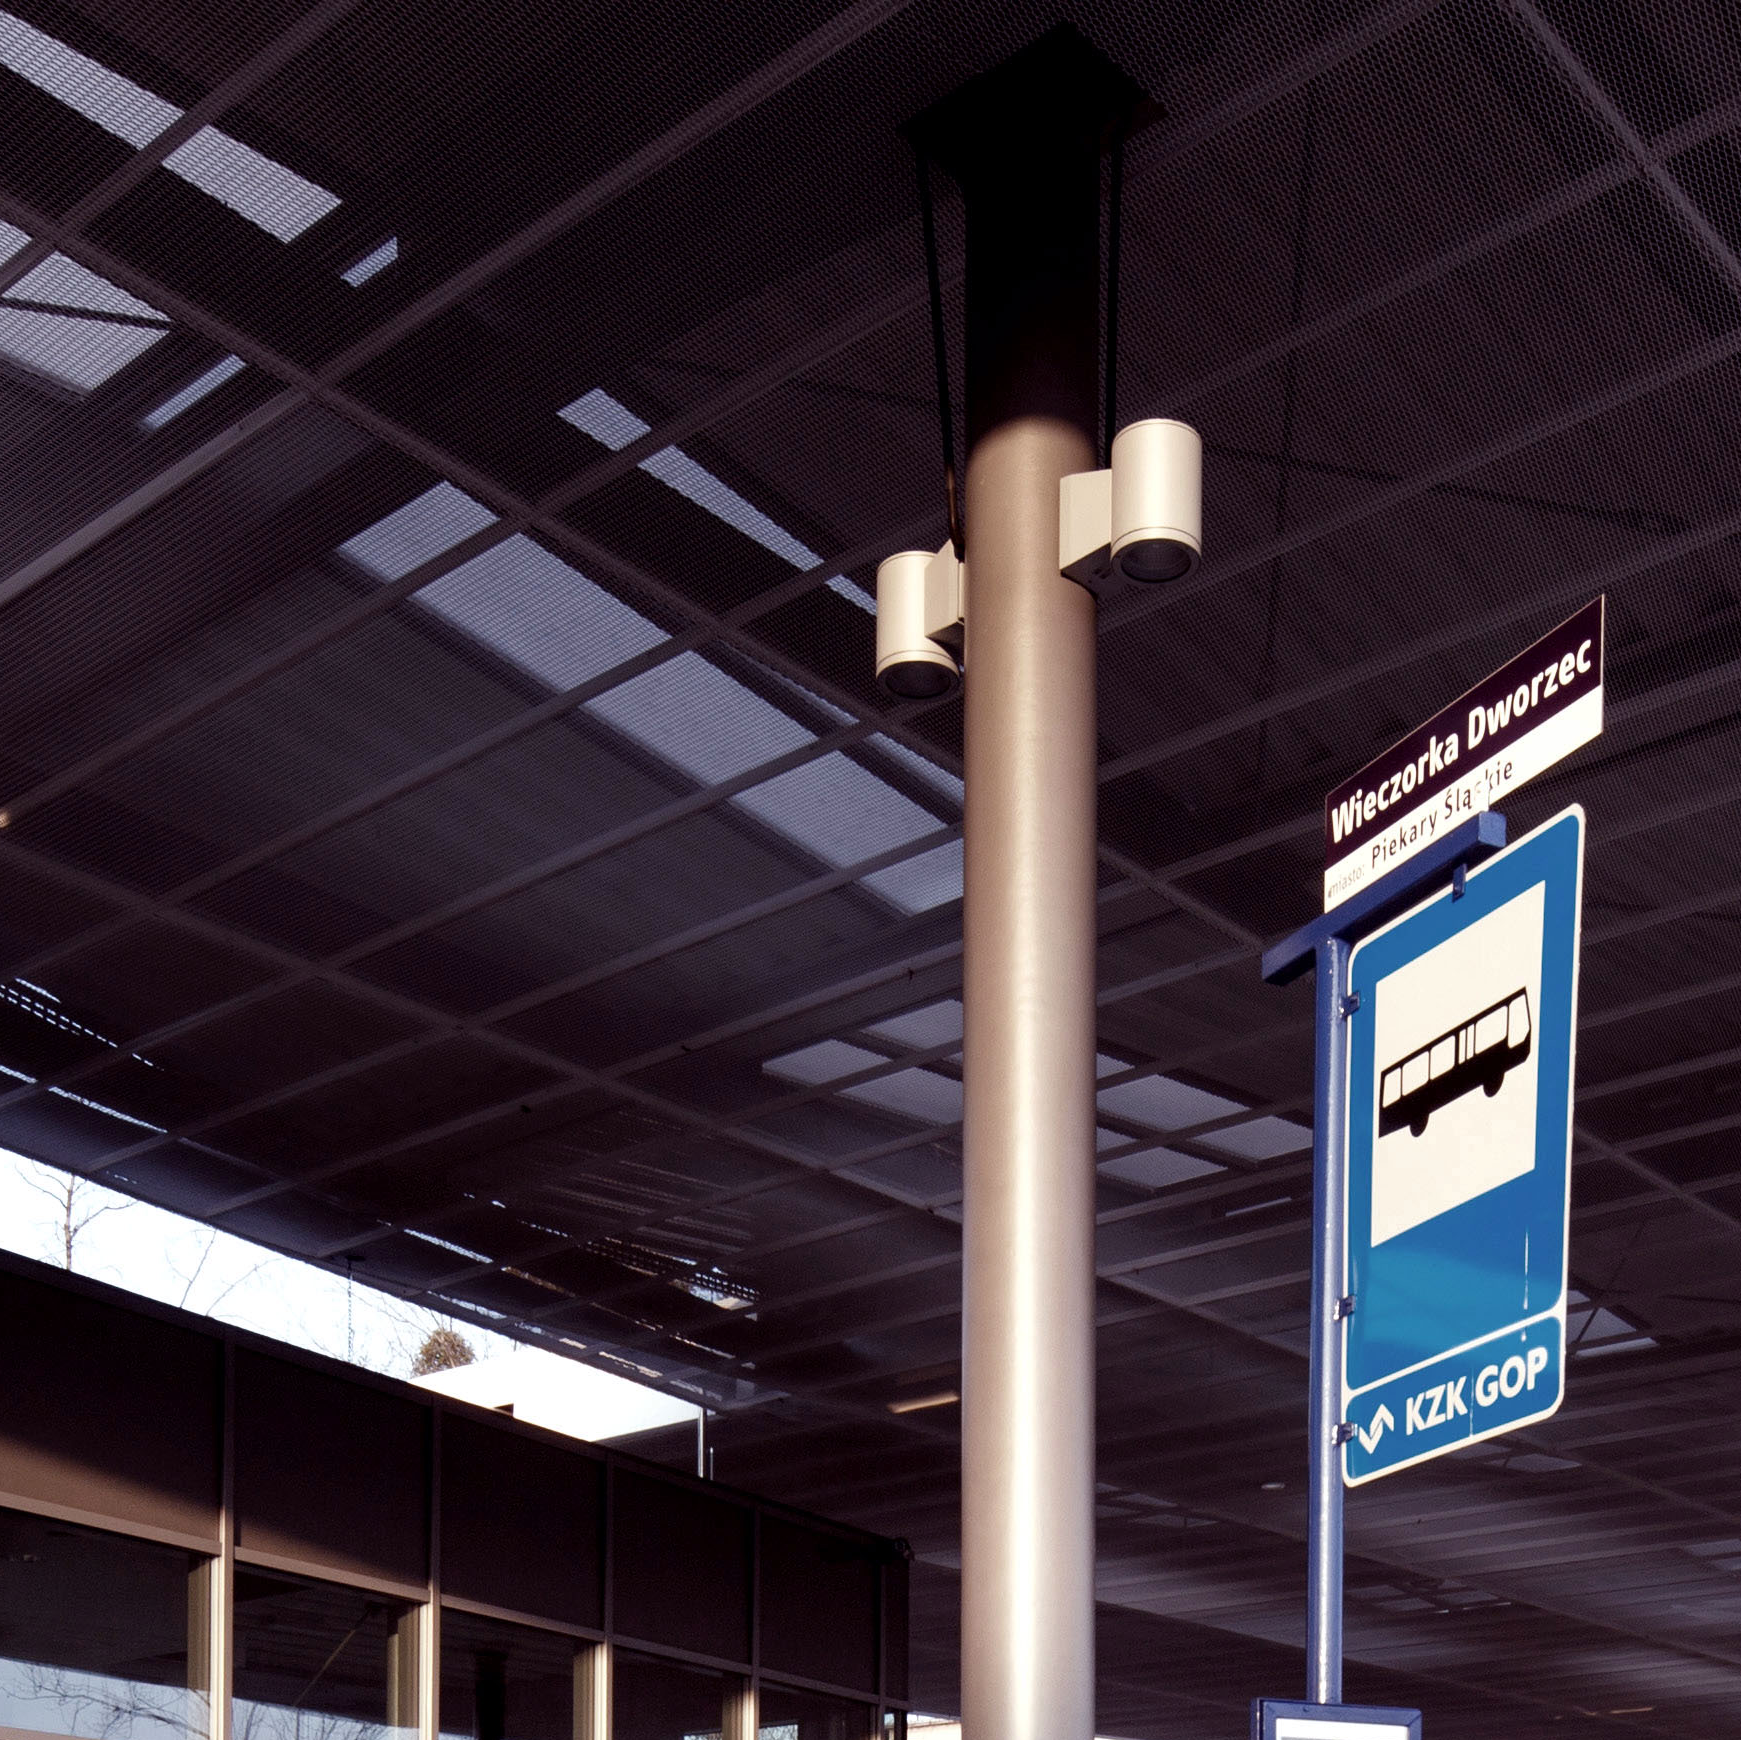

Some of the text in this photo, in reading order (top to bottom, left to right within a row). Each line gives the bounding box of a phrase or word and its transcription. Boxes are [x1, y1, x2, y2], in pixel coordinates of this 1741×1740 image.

[1331, 639, 1592, 843] Wieczorka Dworzec
[1371, 811, 1438, 869] Piekary
[1405, 1346, 1548, 1436] KZK GOP
